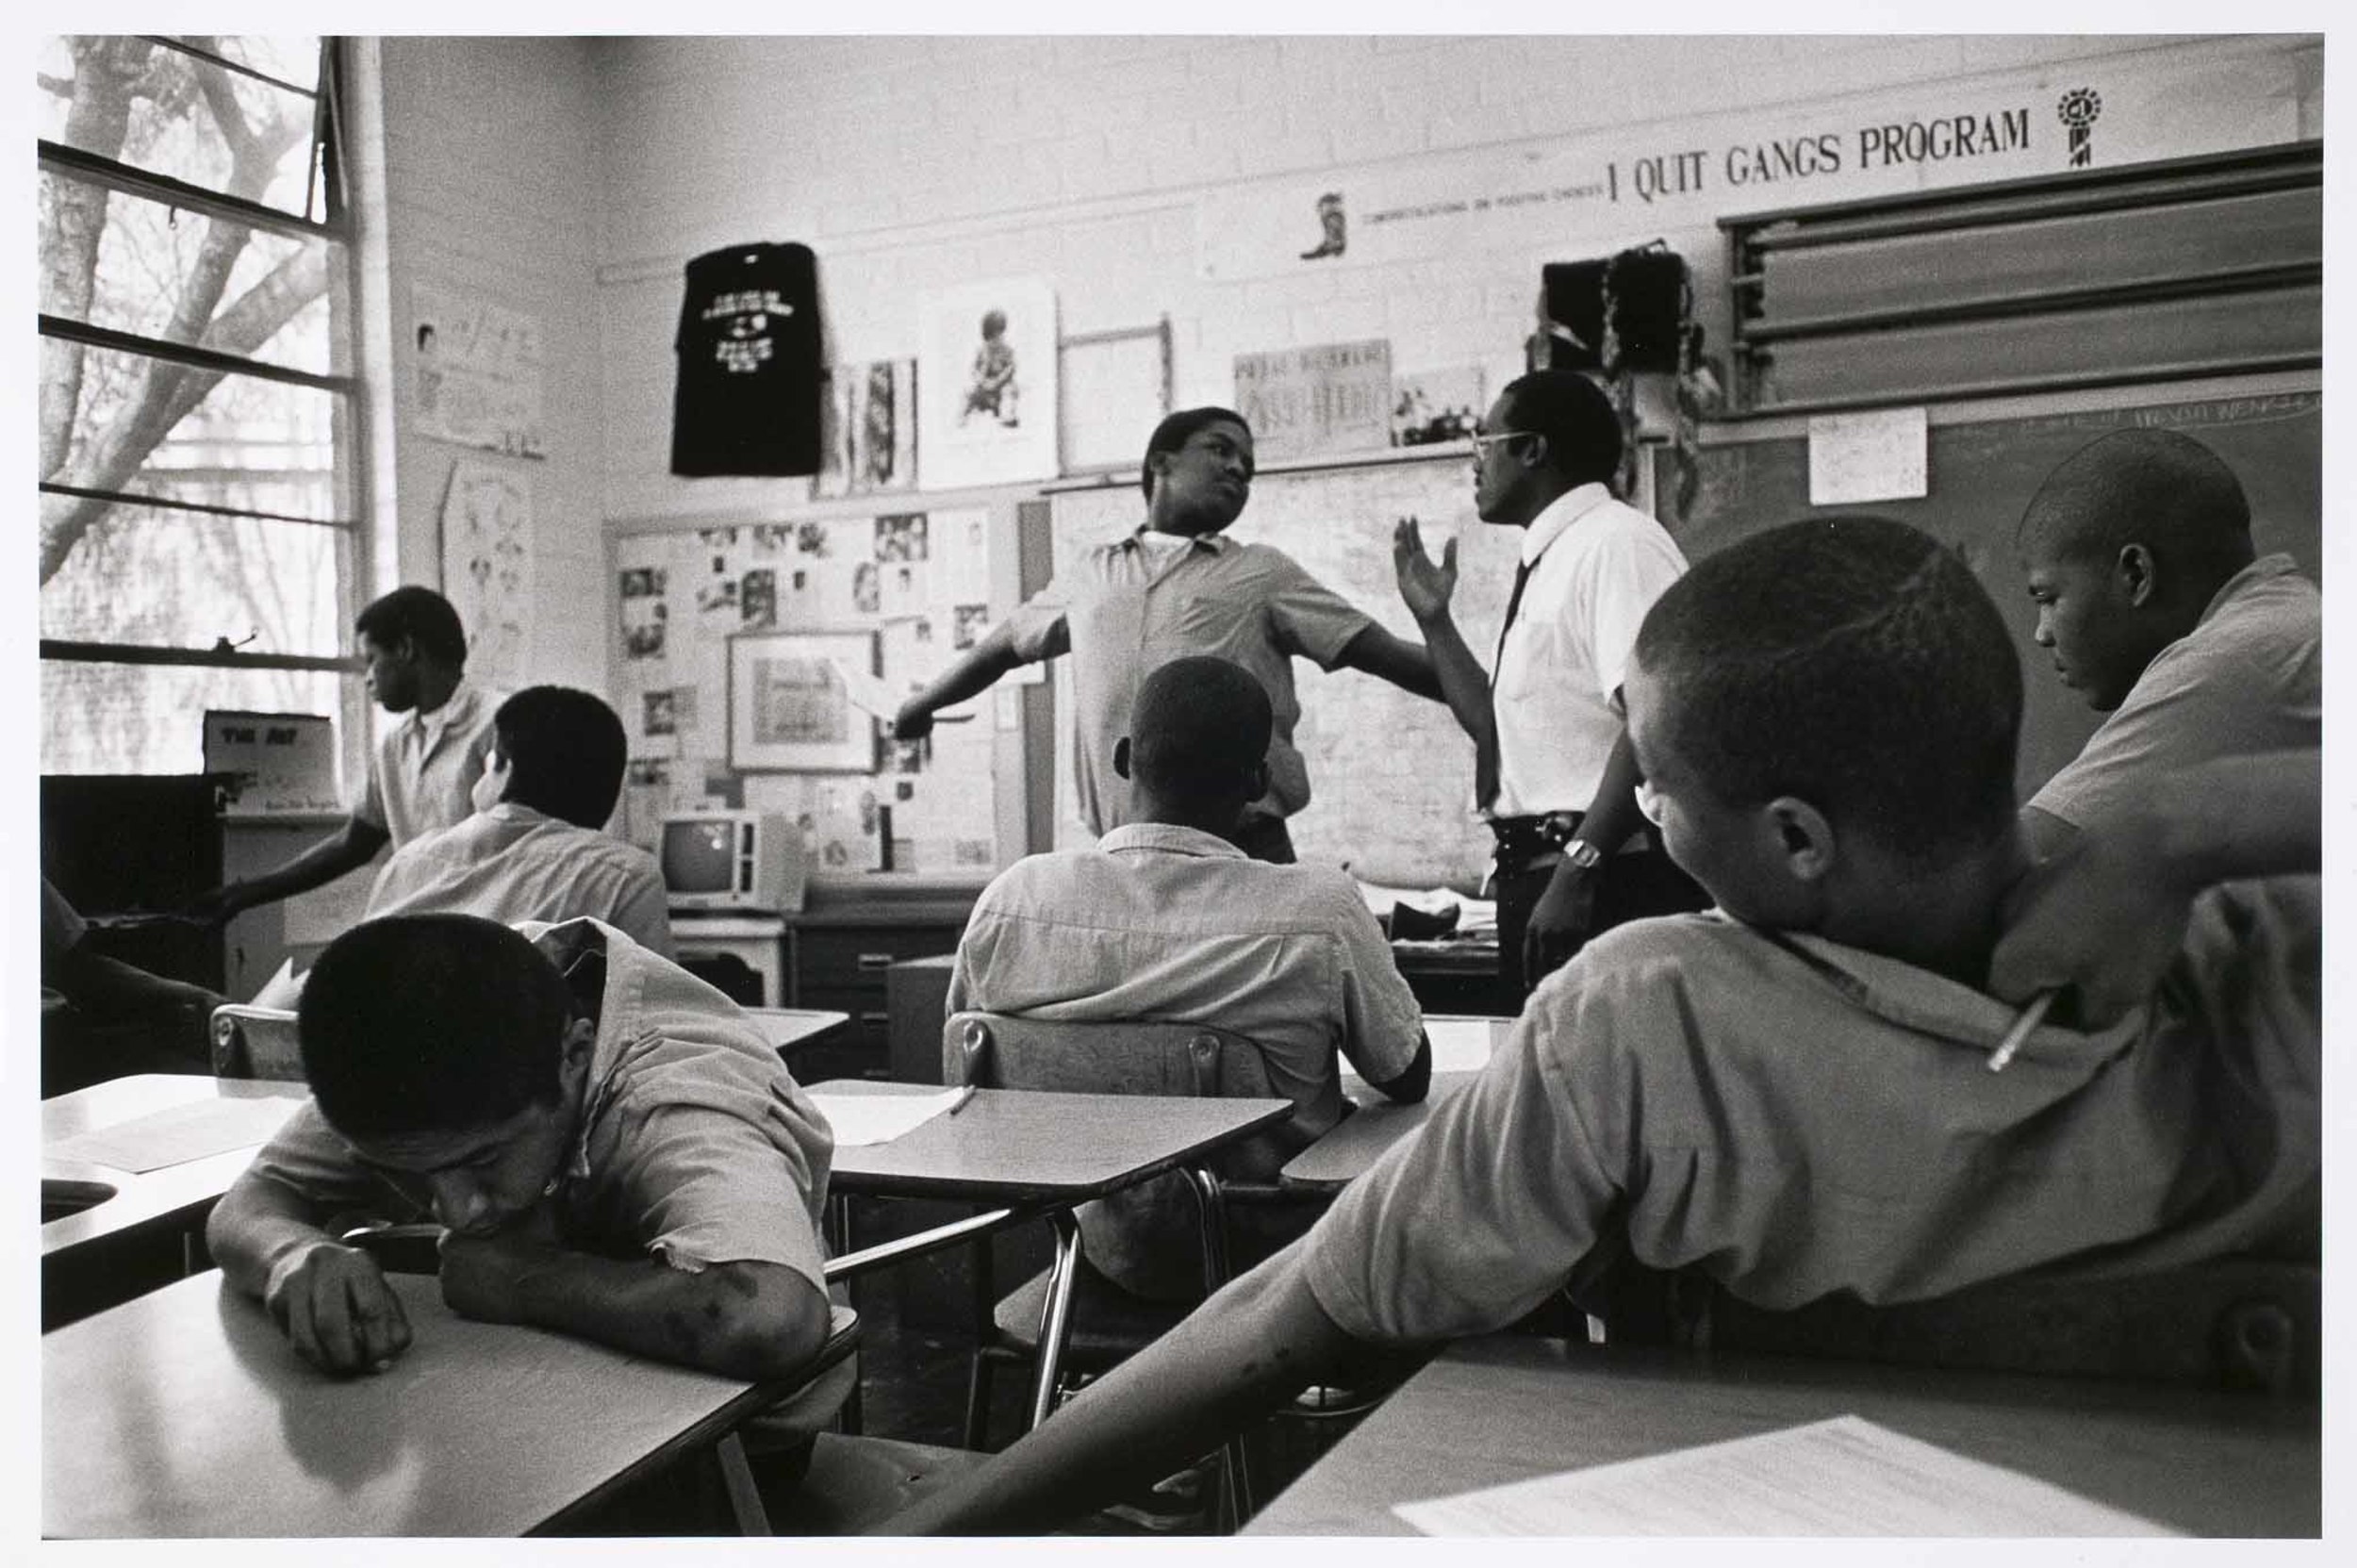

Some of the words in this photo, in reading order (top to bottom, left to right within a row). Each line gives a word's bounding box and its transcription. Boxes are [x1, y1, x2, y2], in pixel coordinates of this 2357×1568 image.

[1607, 163, 1617, 202] I
[1635, 150, 1707, 203] QUIT
[1726, 134, 1841, 186] GANGS
[1859, 108, 2029, 168] PROGRAM
